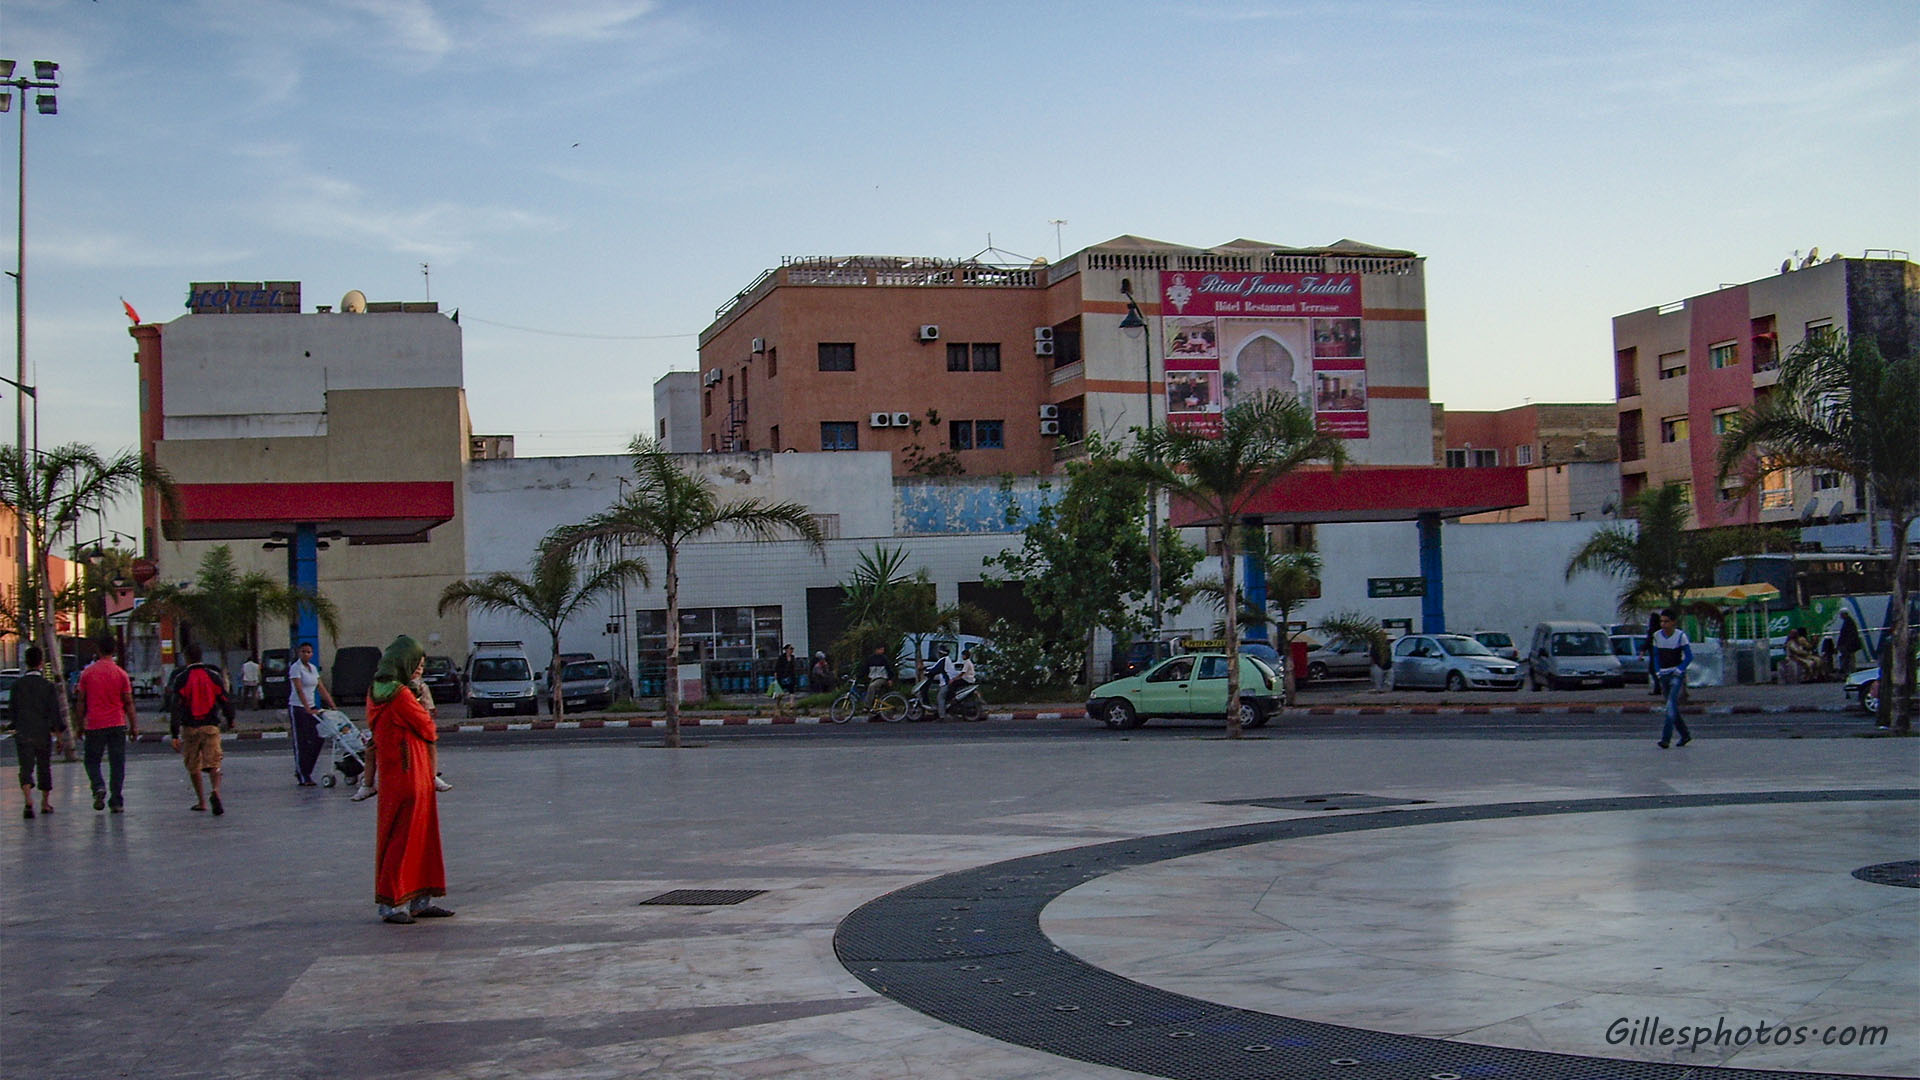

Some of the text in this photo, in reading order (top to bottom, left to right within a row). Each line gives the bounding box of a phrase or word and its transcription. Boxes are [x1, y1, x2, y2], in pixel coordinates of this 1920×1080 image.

[781, 255, 836, 268] HOTEL
[1199, 273, 1352, 297] Riad Jnane Fedala
[184, 289, 284, 308] HOTEL
[1215, 300, 1339, 313] Hôtel Restaurant Terrasse
